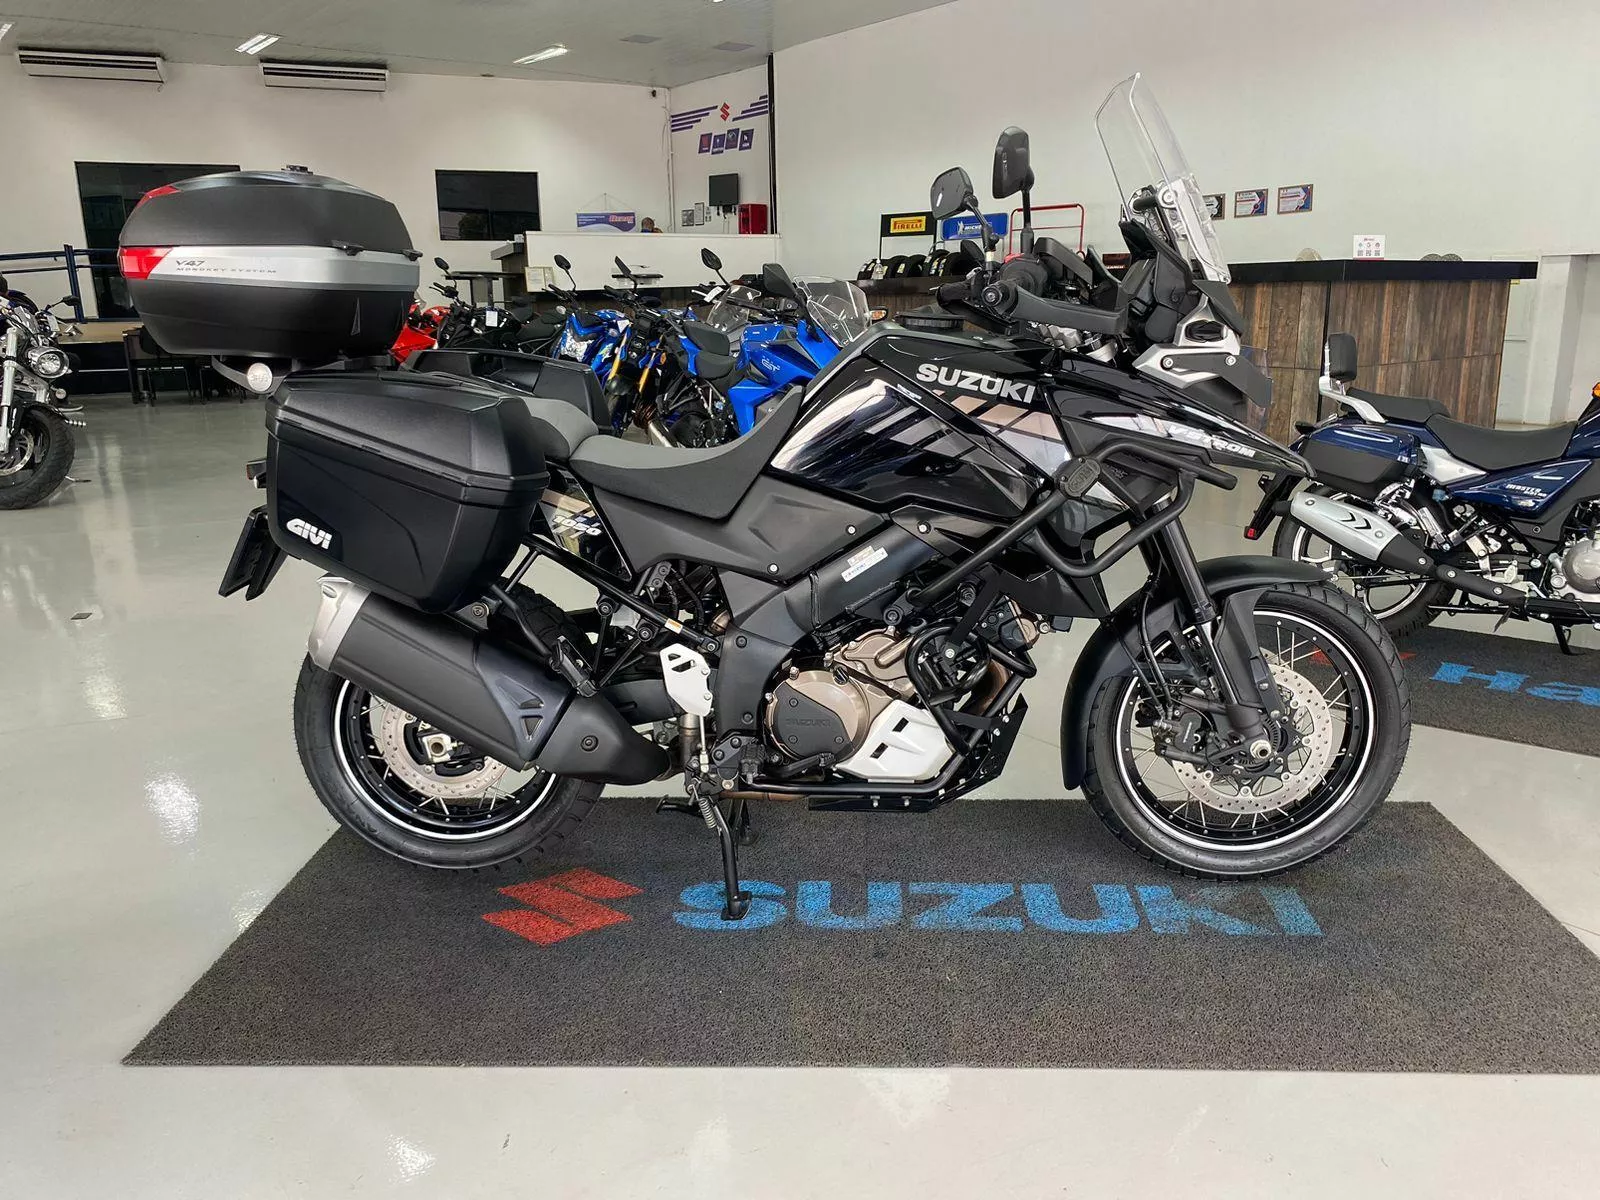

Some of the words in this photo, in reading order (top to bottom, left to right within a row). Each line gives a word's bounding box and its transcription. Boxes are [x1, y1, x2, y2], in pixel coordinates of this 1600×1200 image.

[893, 219, 923, 231] PIRELLI
[916, 363, 1036, 404] SUZUKI
[286, 518, 333, 550] GIVI
[673, 879, 1322, 936] SUZUKI
